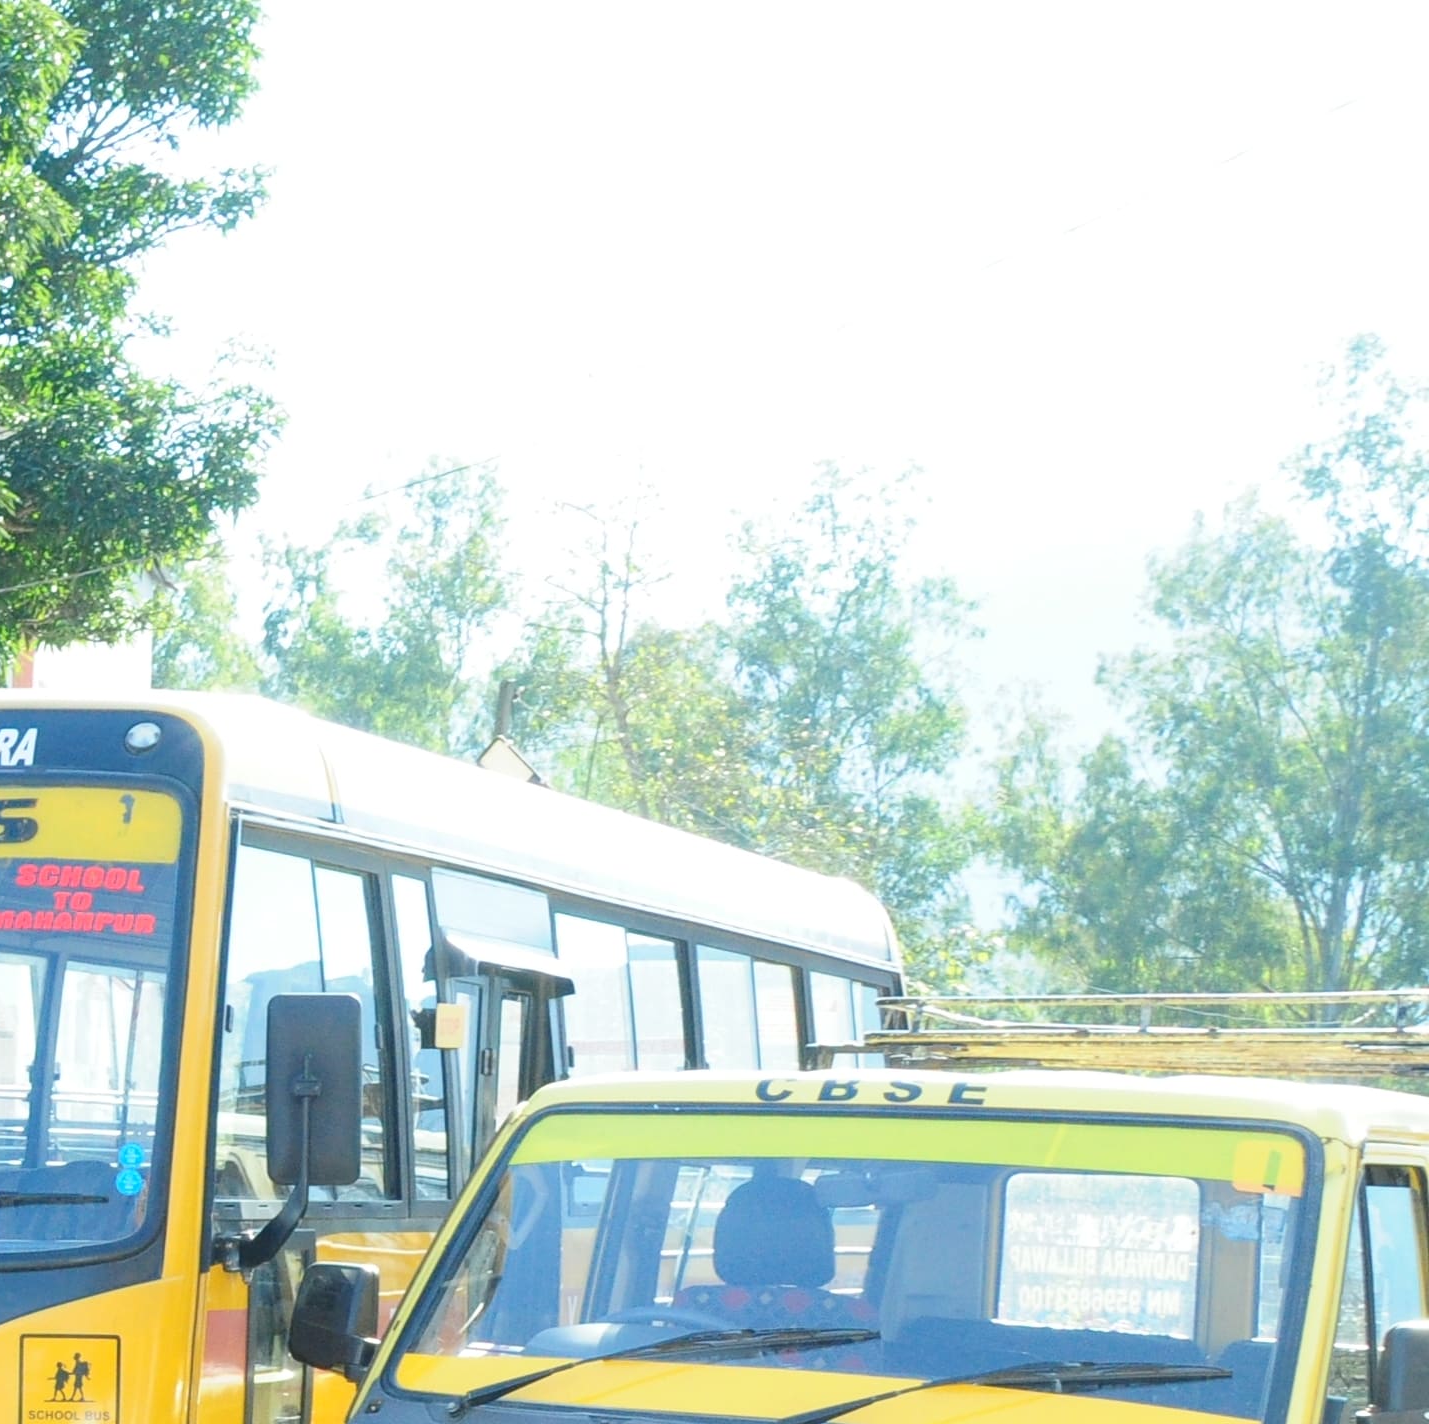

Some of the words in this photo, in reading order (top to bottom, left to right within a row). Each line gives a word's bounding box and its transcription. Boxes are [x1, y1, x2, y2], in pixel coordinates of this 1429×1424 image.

[16, 863, 145, 893] SCHOOL
[53, 891, 94, 912] TO
[28, 1410, 79, 1421] SCHOOL
[85, 1411, 111, 1421] BUS
